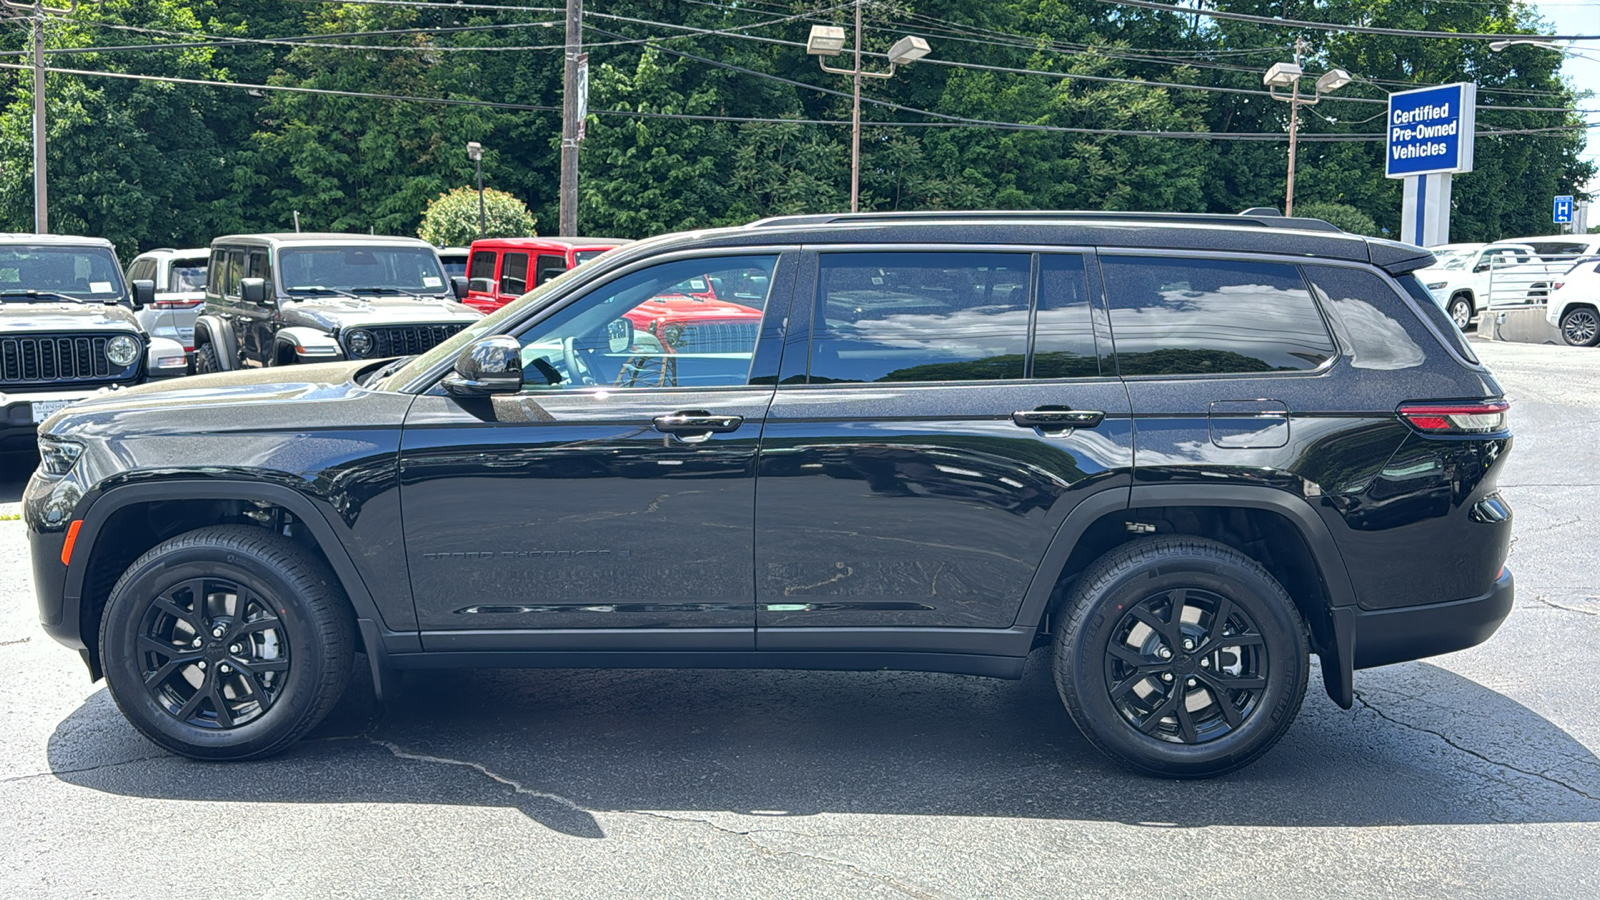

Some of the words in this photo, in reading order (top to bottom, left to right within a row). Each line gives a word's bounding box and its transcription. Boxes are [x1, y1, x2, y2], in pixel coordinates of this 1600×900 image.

[1393, 103, 1449, 124] Certified
[1392, 120, 1457, 142] Pre-Owned
[1392, 142, 1447, 160] Vehicles
[1558, 202, 1568, 215] H
